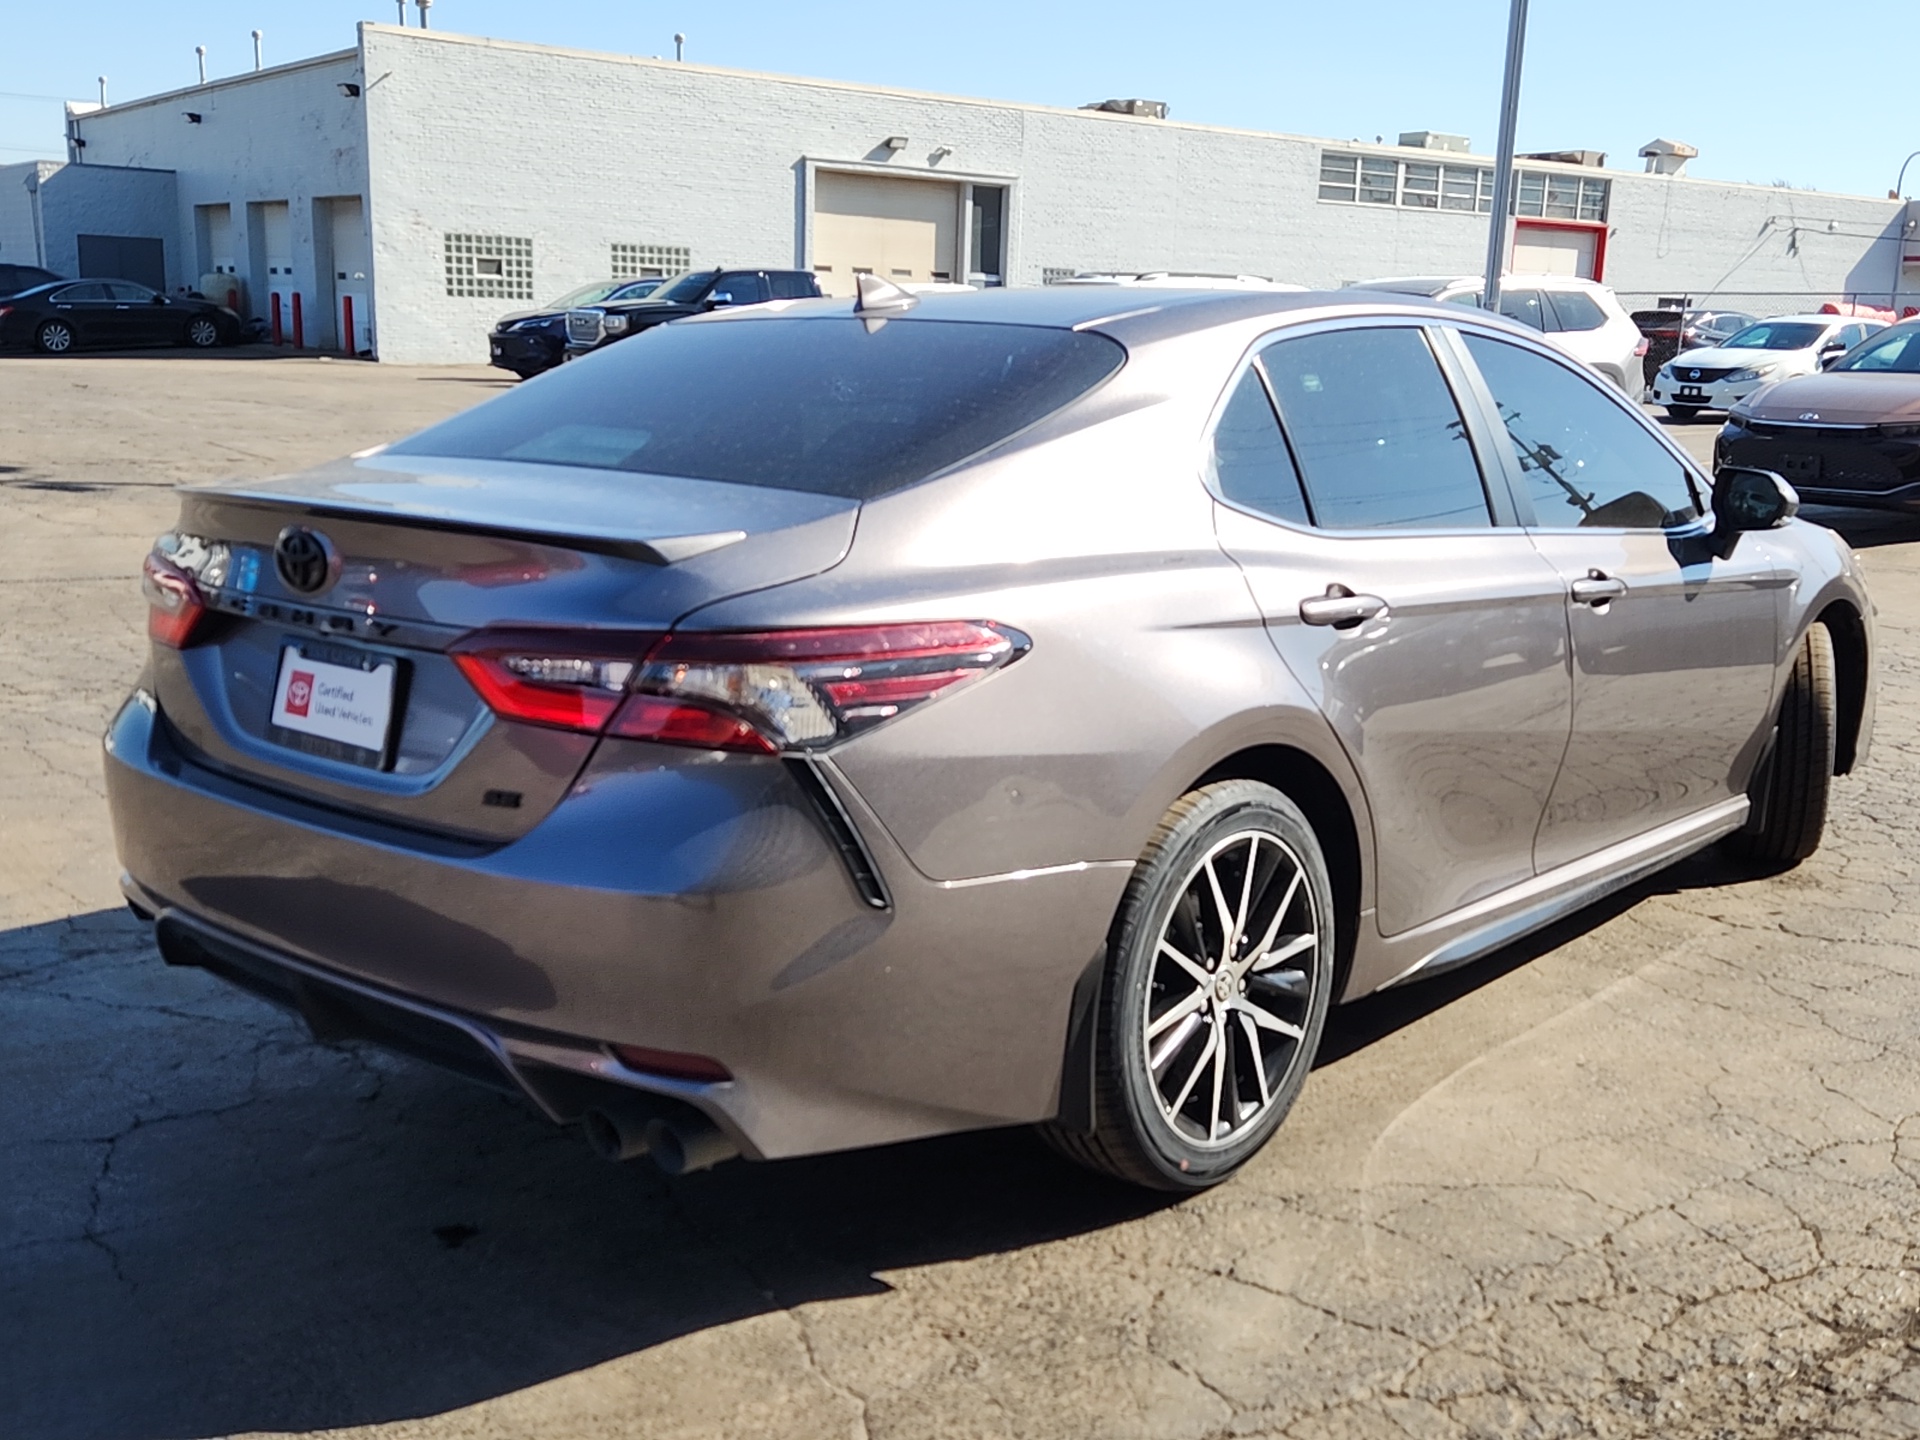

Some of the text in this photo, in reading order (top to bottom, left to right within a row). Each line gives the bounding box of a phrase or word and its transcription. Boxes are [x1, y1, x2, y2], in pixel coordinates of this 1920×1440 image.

[318, 682, 354, 702] Certified
[315, 701, 373, 726] Used Vehicles
